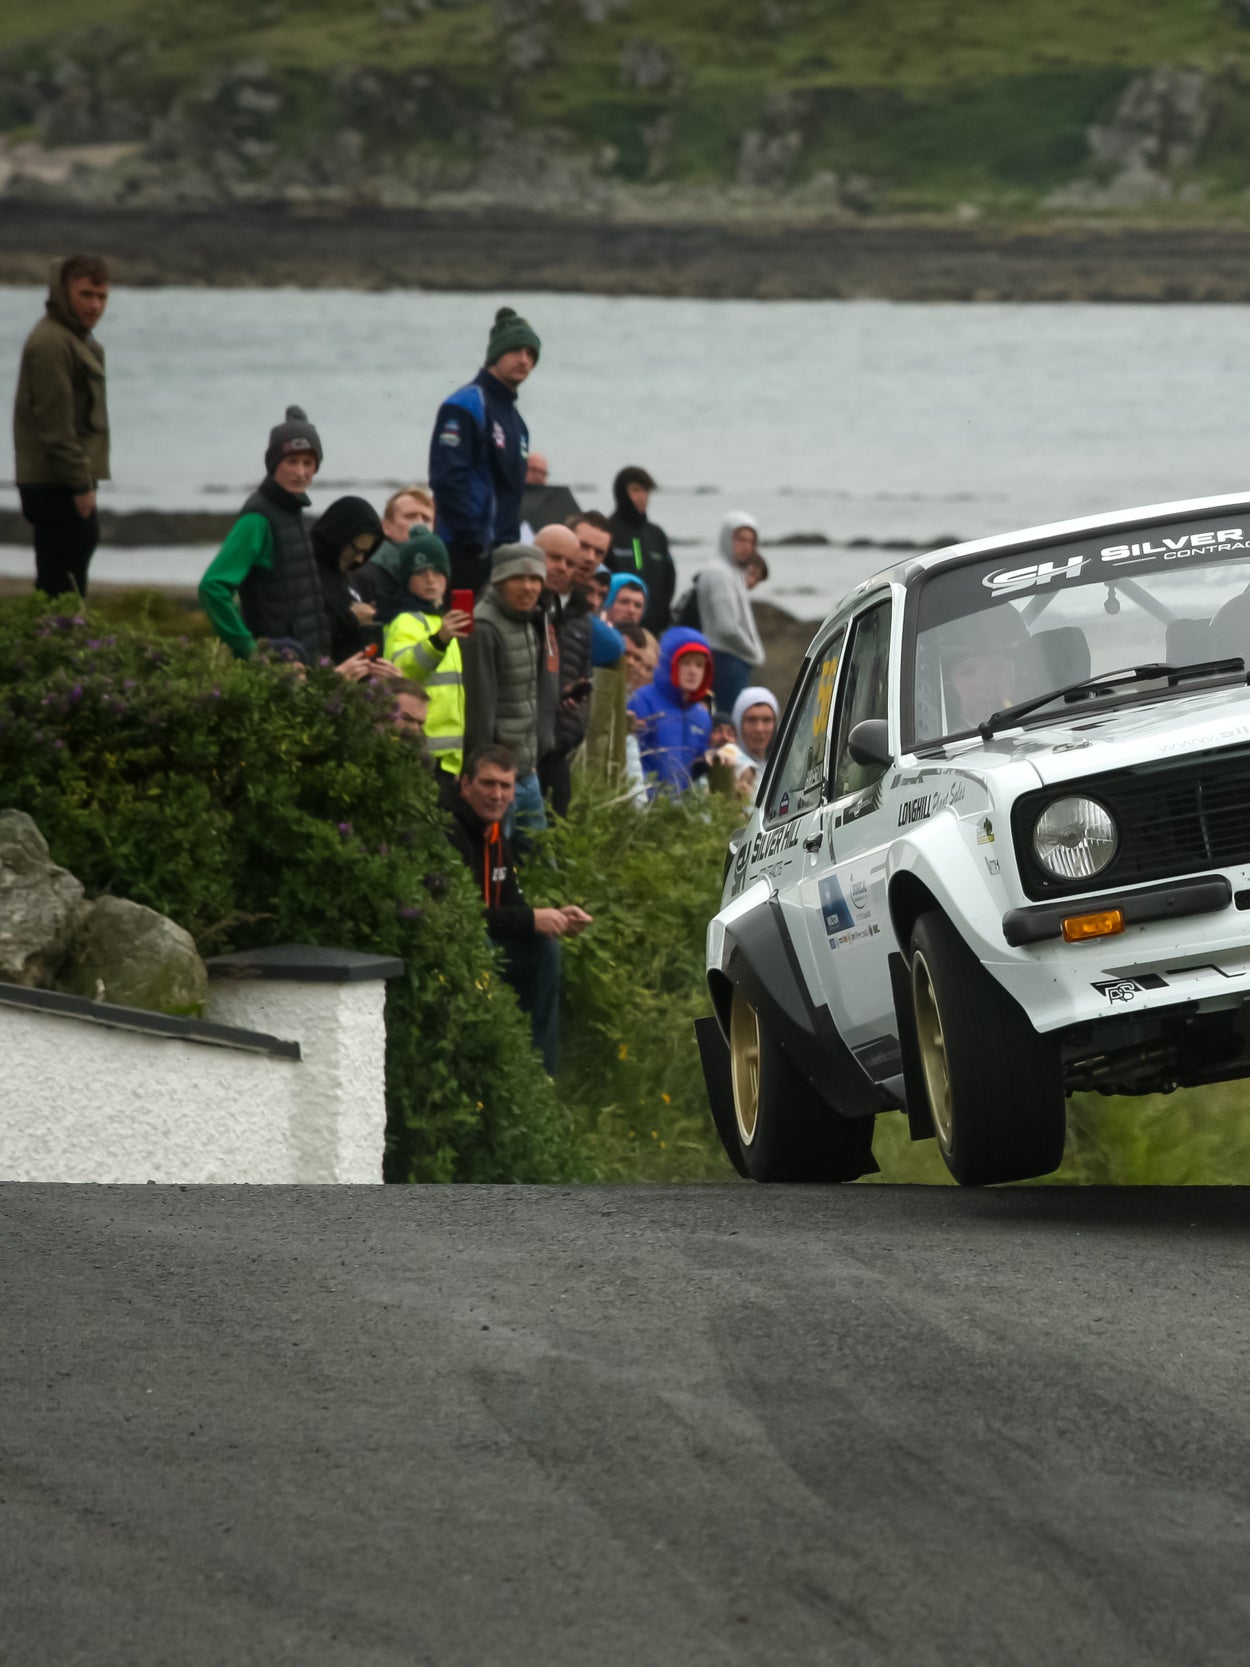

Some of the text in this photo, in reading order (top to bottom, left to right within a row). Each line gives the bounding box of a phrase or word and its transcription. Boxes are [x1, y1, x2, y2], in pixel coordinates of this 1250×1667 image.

[1100, 528, 1243, 562] SILVER
[983, 555, 1091, 597] SH
[898, 794, 932, 827] LONGHILL
[751, 819, 802, 865] SILVER HILL
[1106, 982, 1135, 1005] RS
